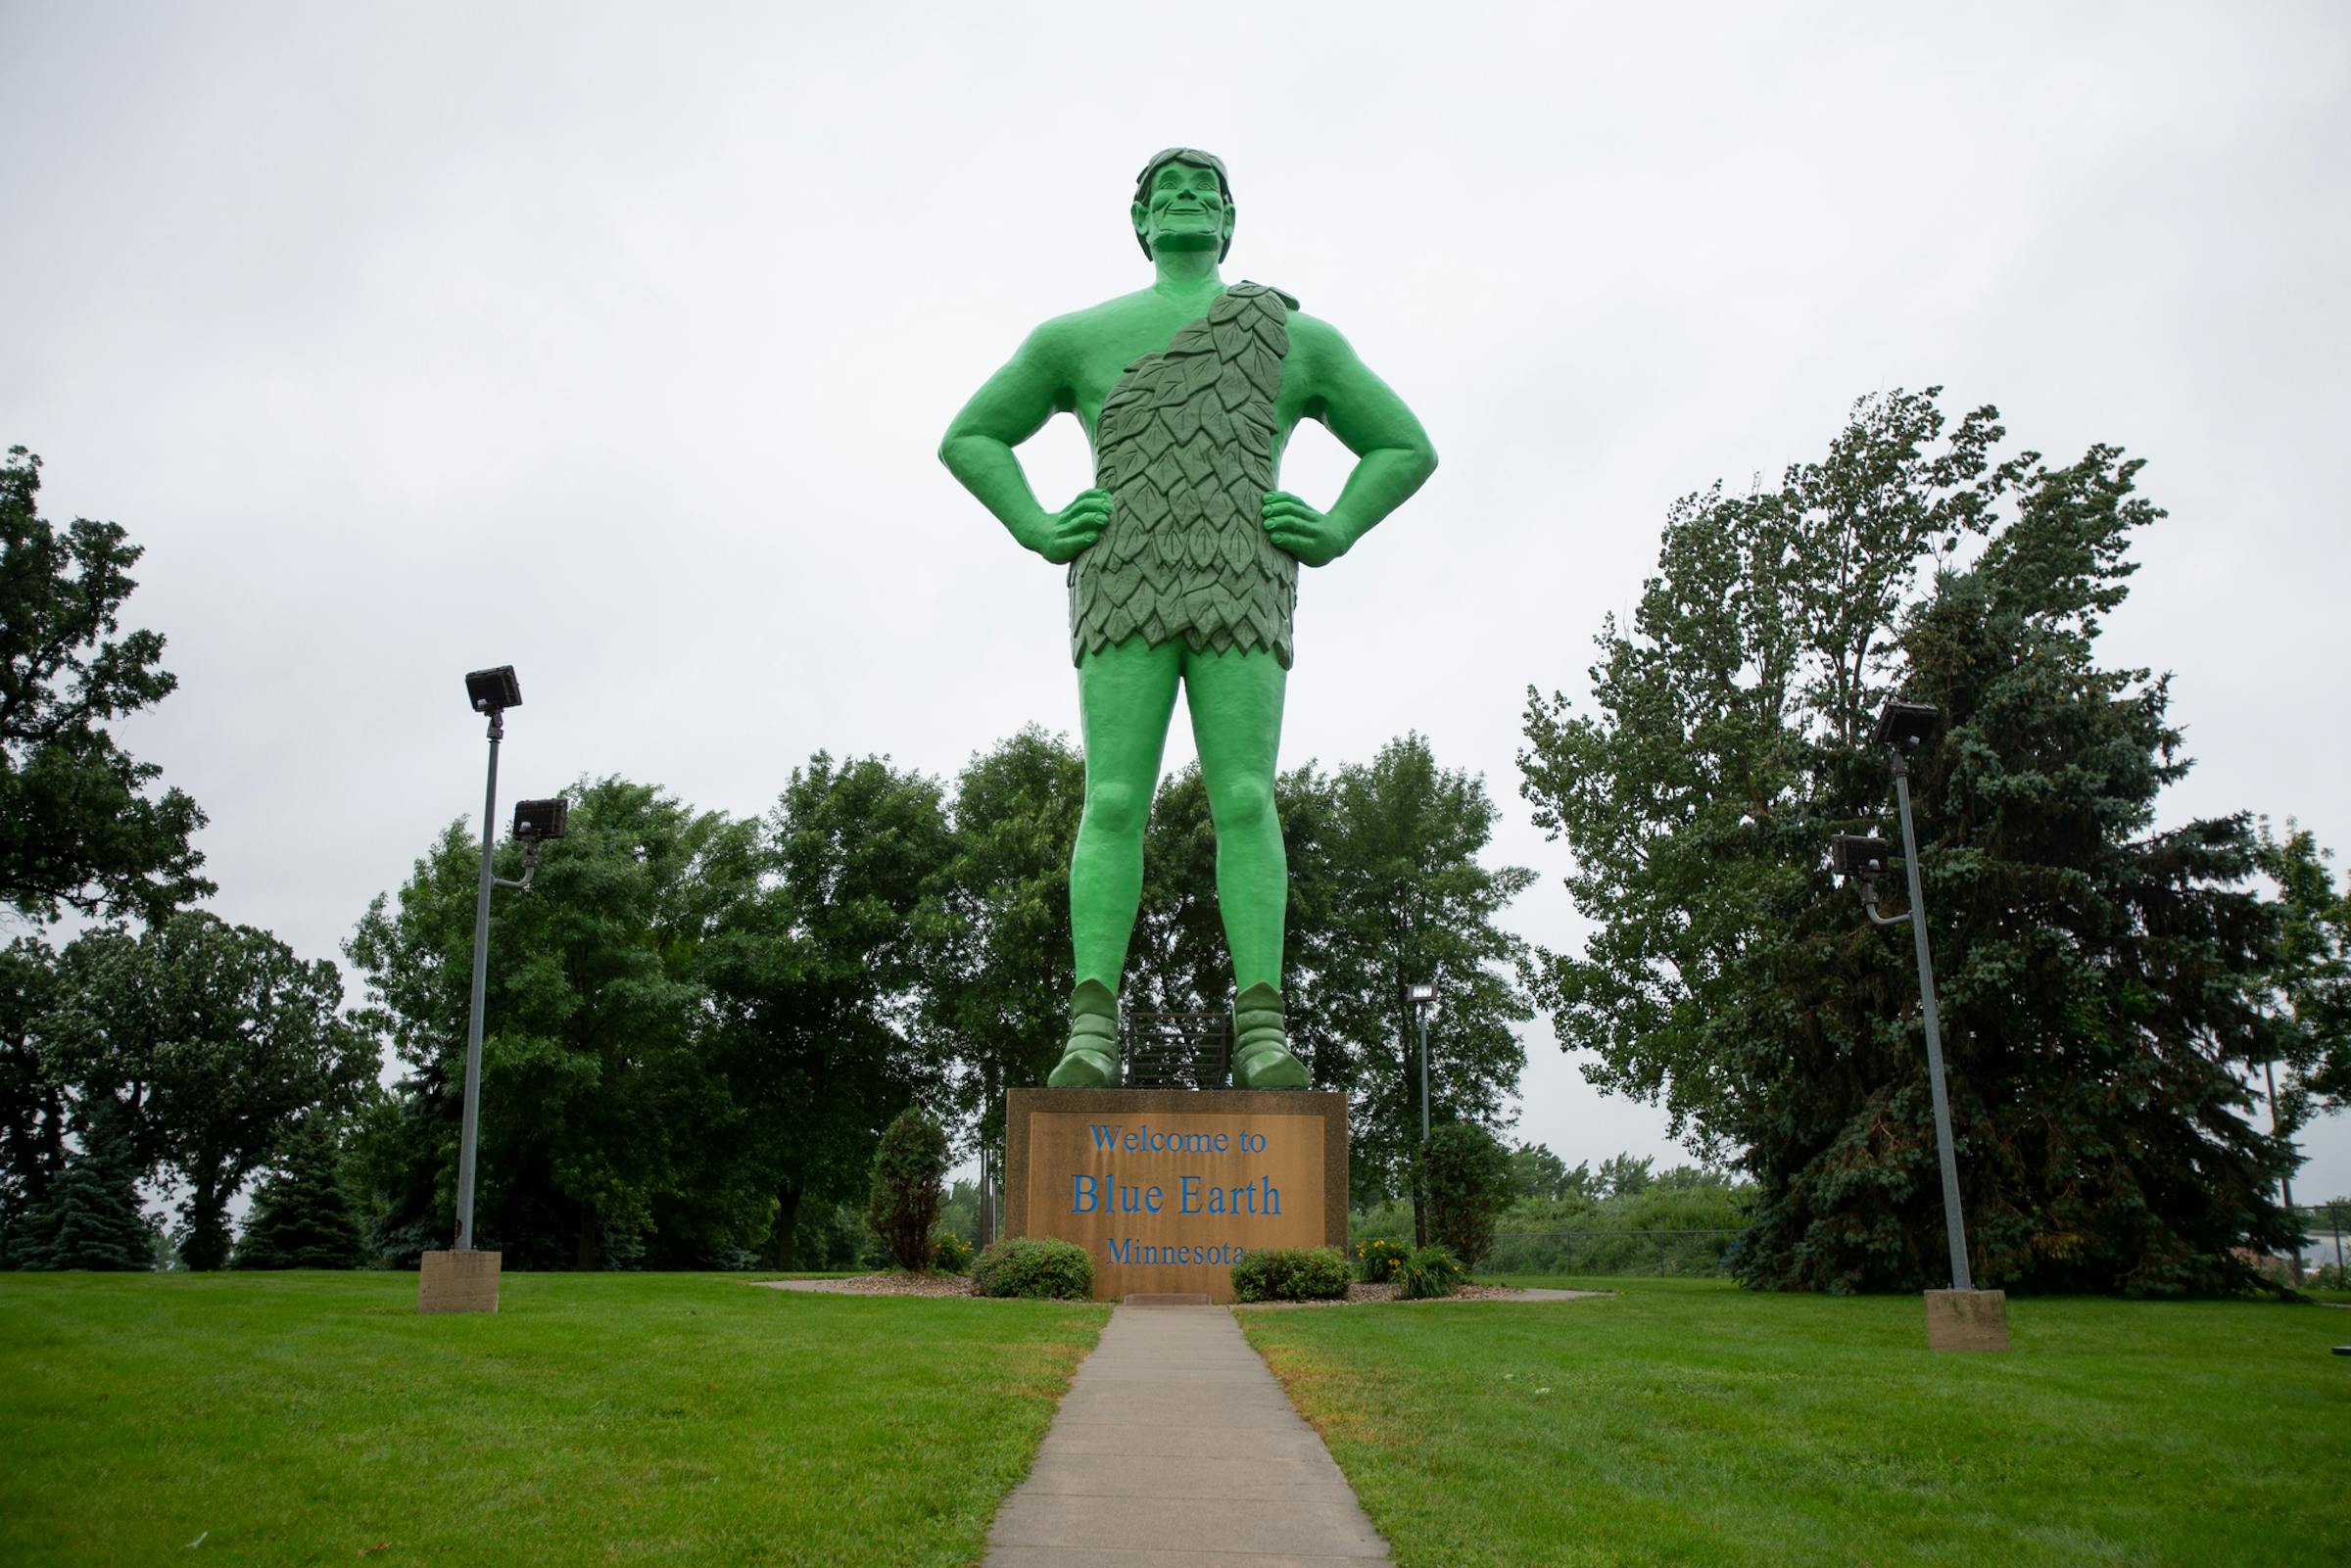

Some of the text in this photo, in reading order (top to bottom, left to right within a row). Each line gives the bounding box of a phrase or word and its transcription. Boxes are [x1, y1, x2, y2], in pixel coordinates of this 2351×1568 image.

[1089, 1124, 1267, 1153] Welcome to
[1072, 1174, 1281, 1215] Blue Earth
[1106, 1238, 1244, 1265] Minnesota
